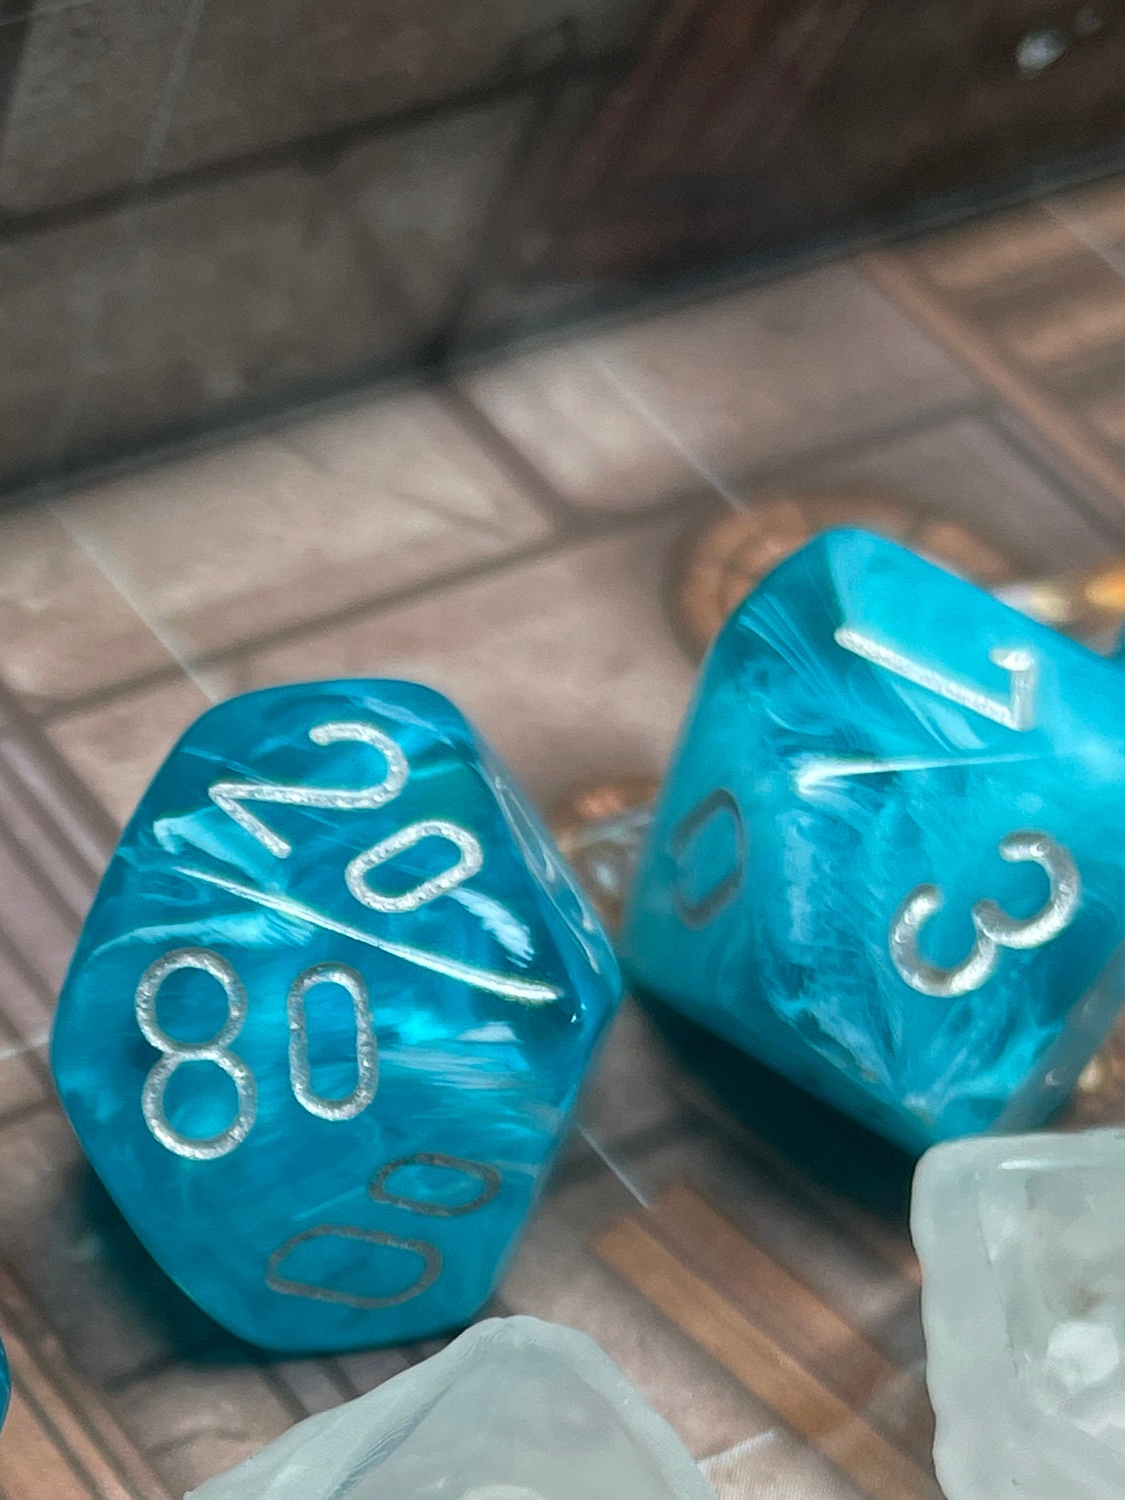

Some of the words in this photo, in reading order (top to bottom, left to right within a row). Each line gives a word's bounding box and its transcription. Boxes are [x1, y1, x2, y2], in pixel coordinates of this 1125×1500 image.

[208, 721, 484, 914] 20
[888, 830, 1082, 998] 3
[134, 946, 378, 1162] 80
